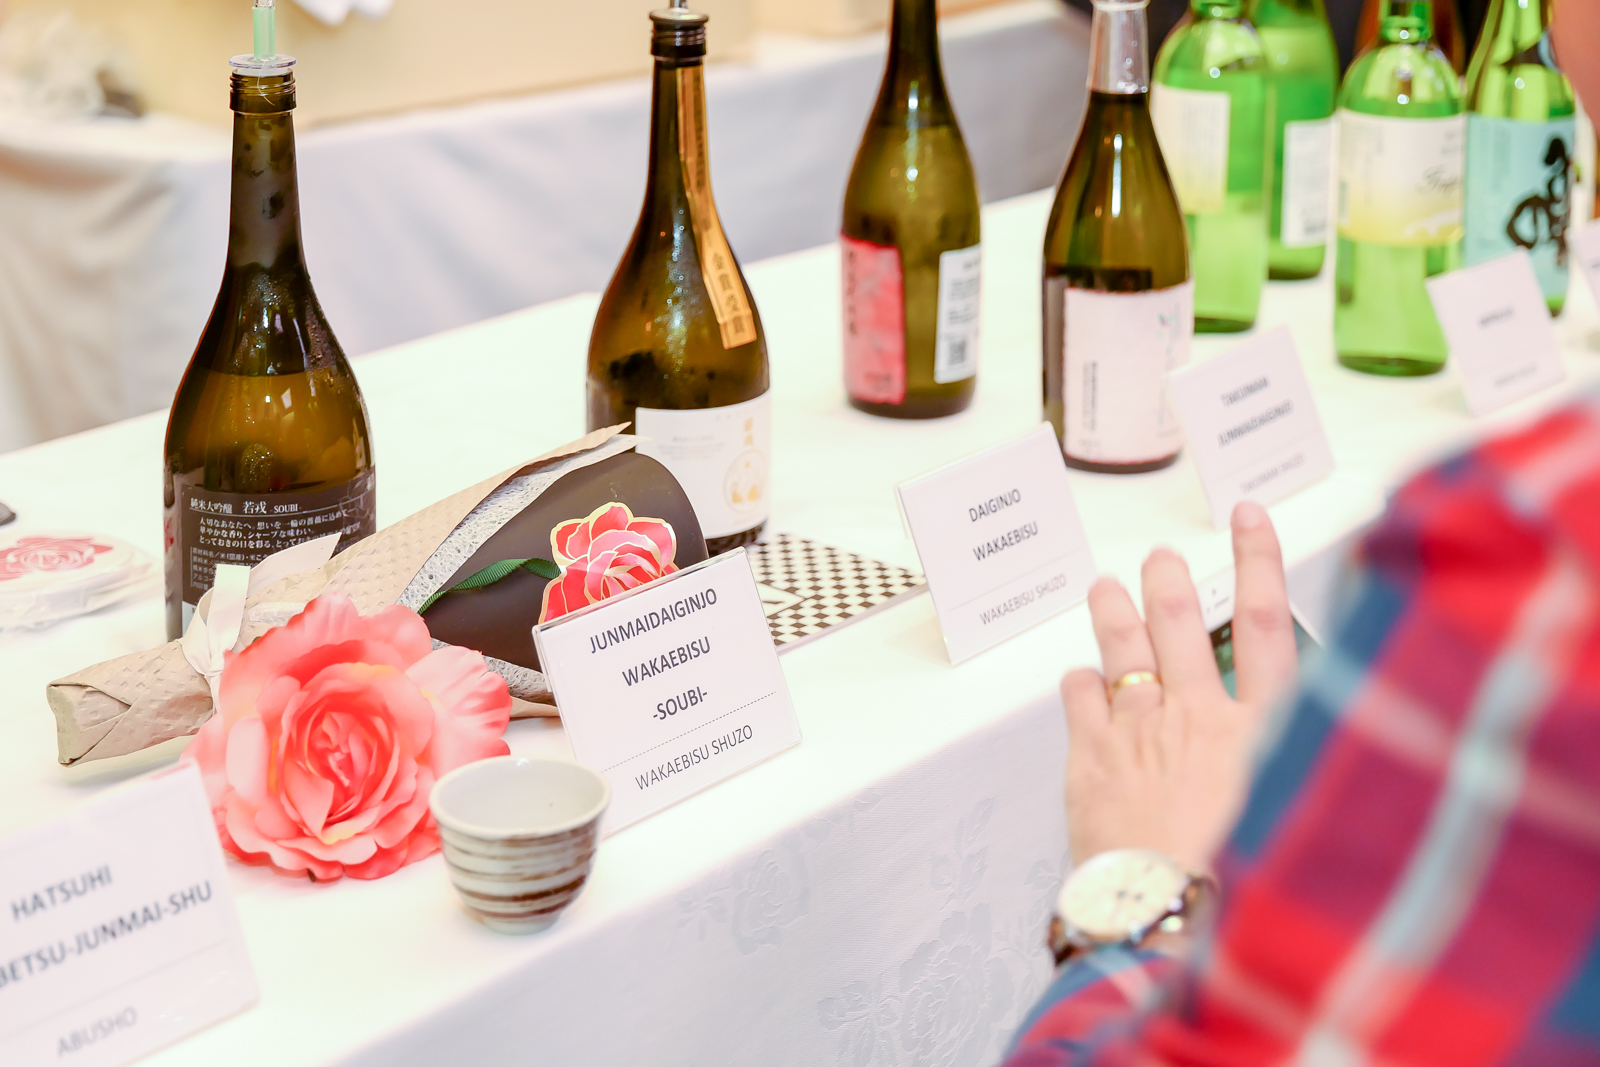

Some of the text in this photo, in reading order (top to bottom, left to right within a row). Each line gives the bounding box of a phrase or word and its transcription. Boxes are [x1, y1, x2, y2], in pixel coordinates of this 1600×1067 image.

[190, 497, 233, 515] 純米大吟醸
[243, 500, 267, 515] 若戎
[968, 488, 1021, 522] DAIGINJO
[973, 521, 1039, 561] WAKAEBISU
[590, 588, 717, 654] JUNMAIDAIGINJO
[979, 573, 1067, 625] WAKAEBISU SHUZO
[622, 636, 711, 687] WAKAEBISU
[653, 686, 708, 720] -SOUBI-
[635, 724, 753, 790] WAKAEBISU SHUZO
[10, 864, 113, 922] HATSUHI
[57, 1006, 138, 1057] ABUSHO
